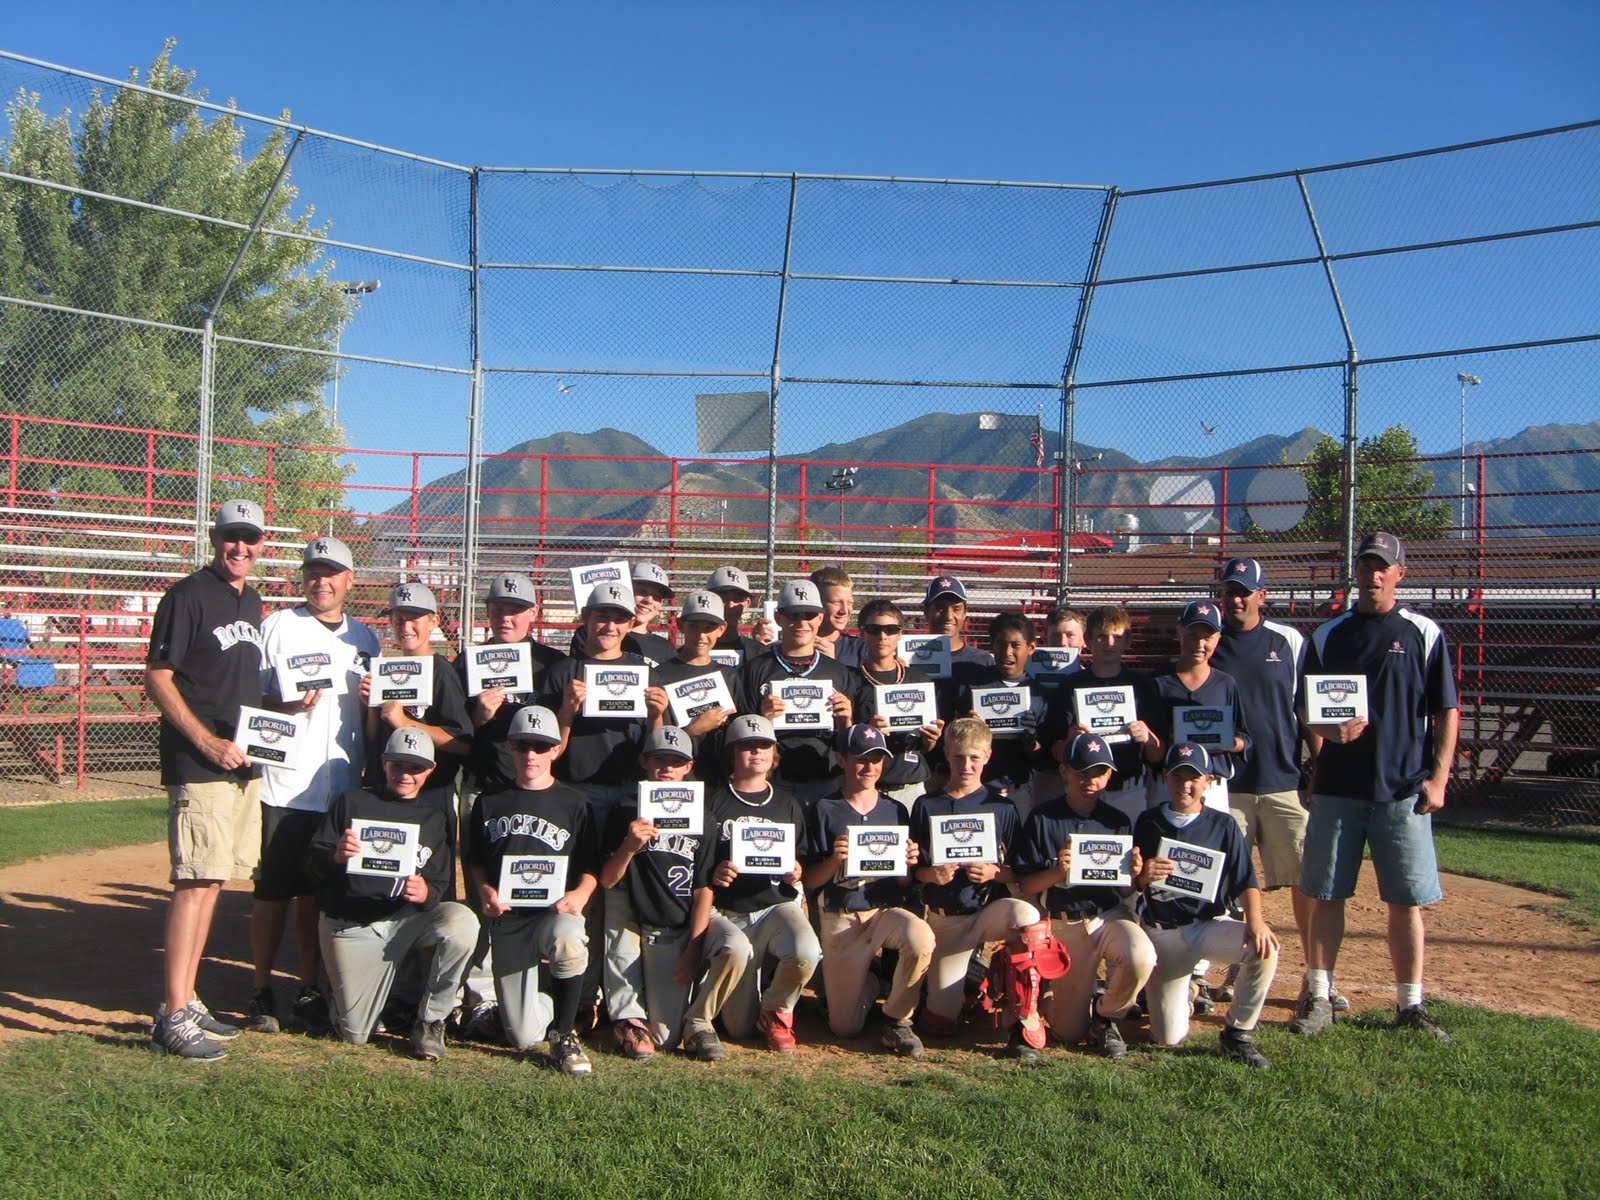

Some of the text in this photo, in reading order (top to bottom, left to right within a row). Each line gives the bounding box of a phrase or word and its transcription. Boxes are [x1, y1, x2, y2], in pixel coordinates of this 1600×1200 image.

[582, 569, 621, 583] LABORDAY
[288, 654, 331, 668] LABORDAY
[477, 650, 520, 664] LABORDAY
[380, 663, 422, 675] LABORDAY
[597, 673, 639, 685] LABORDAY
[676, 679, 716, 697] LABORDAY
[782, 687, 823, 698] LABORDAY
[1317, 682, 1358, 692] LABORDAY
[886, 691, 925, 703] LABORDAY
[982, 693, 1020, 706] LABORDAY
[1086, 692, 1125, 705] LABORDAY
[250, 718, 296, 736] LABORDAY
[651, 789, 694, 801] LABORDAY
[485, 813, 571, 851] ROCKIES
[942, 820, 984, 833] LABORDAY
[362, 828, 406, 844] LABORDAY
[743, 829, 785, 841] LABORDAY
[858, 834, 900, 845] LABORDAY
[1080, 842, 1122, 854] LABORDAY
[1169, 848, 1213, 868] LABORDAY
[511, 861, 555, 874] LABORDAY
